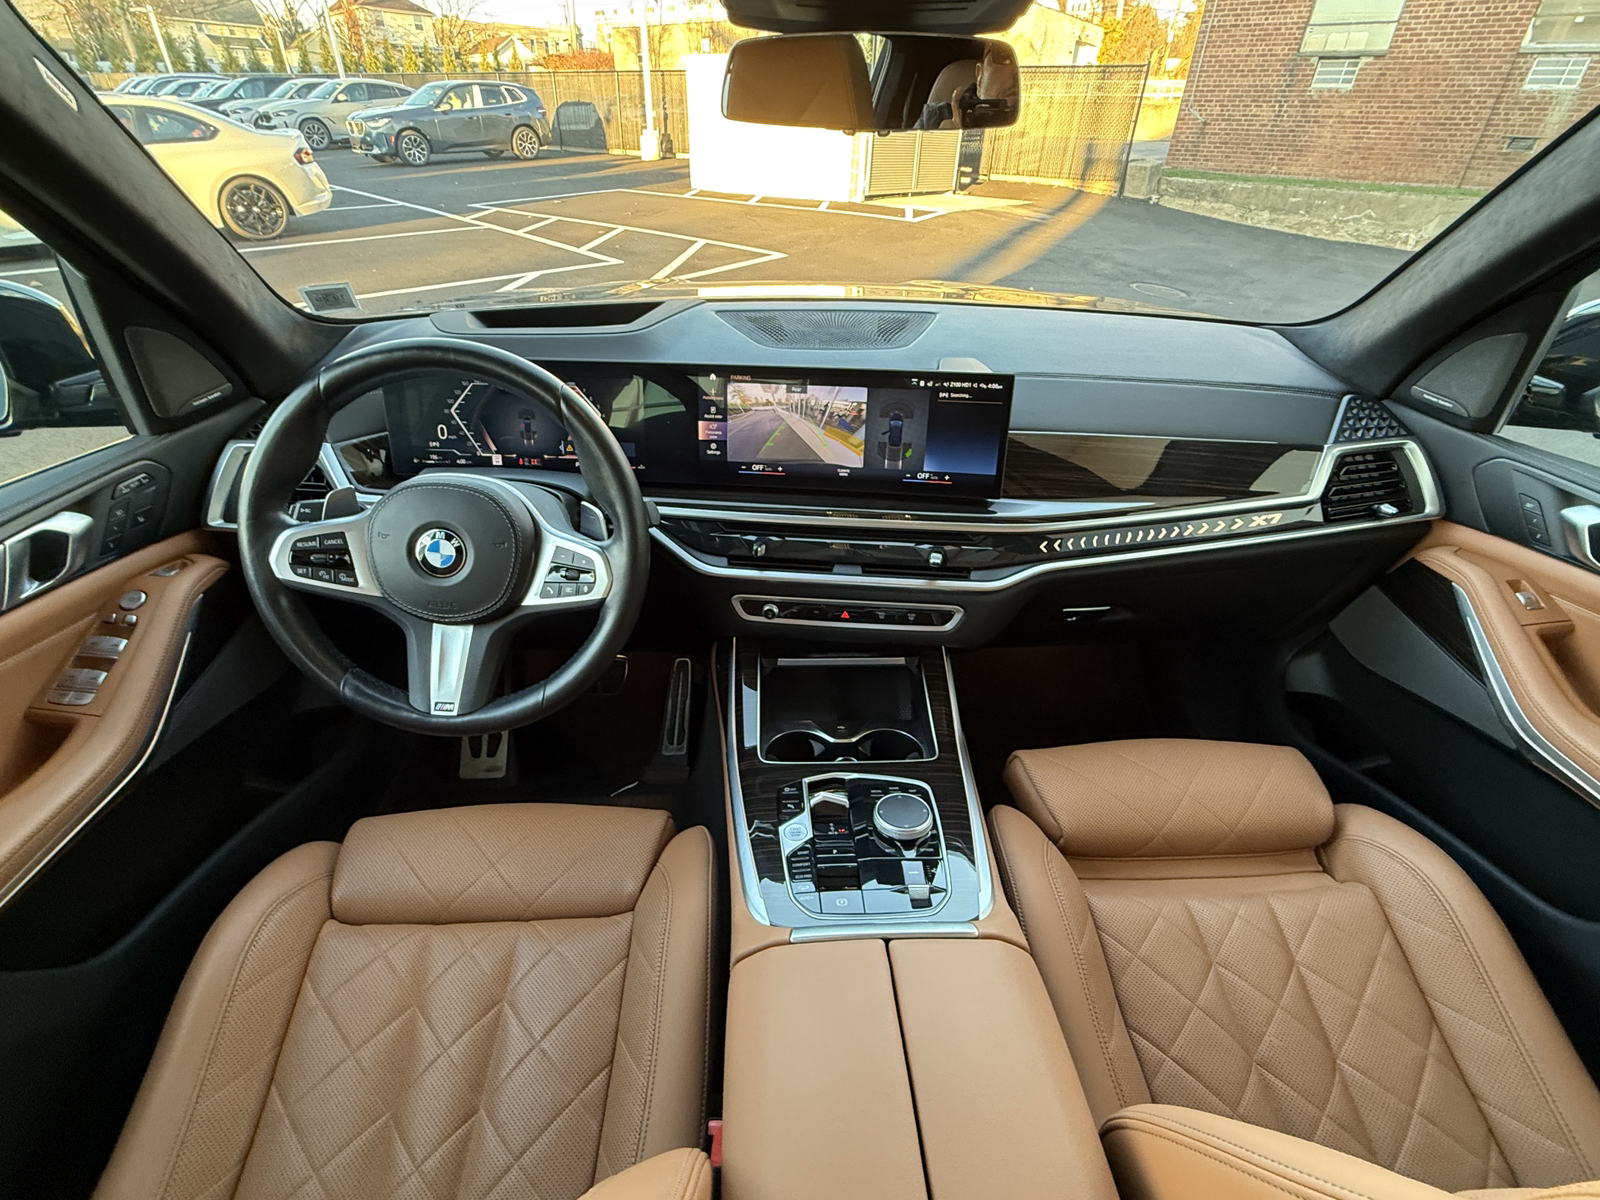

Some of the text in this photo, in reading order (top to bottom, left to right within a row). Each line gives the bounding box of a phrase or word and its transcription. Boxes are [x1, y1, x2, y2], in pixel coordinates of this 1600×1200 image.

[437, 424, 448, 440] 0
[917, 472, 930, 480] OFF
[1249, 513, 1283, 528] X7
[421, 531, 461, 548] BMW
